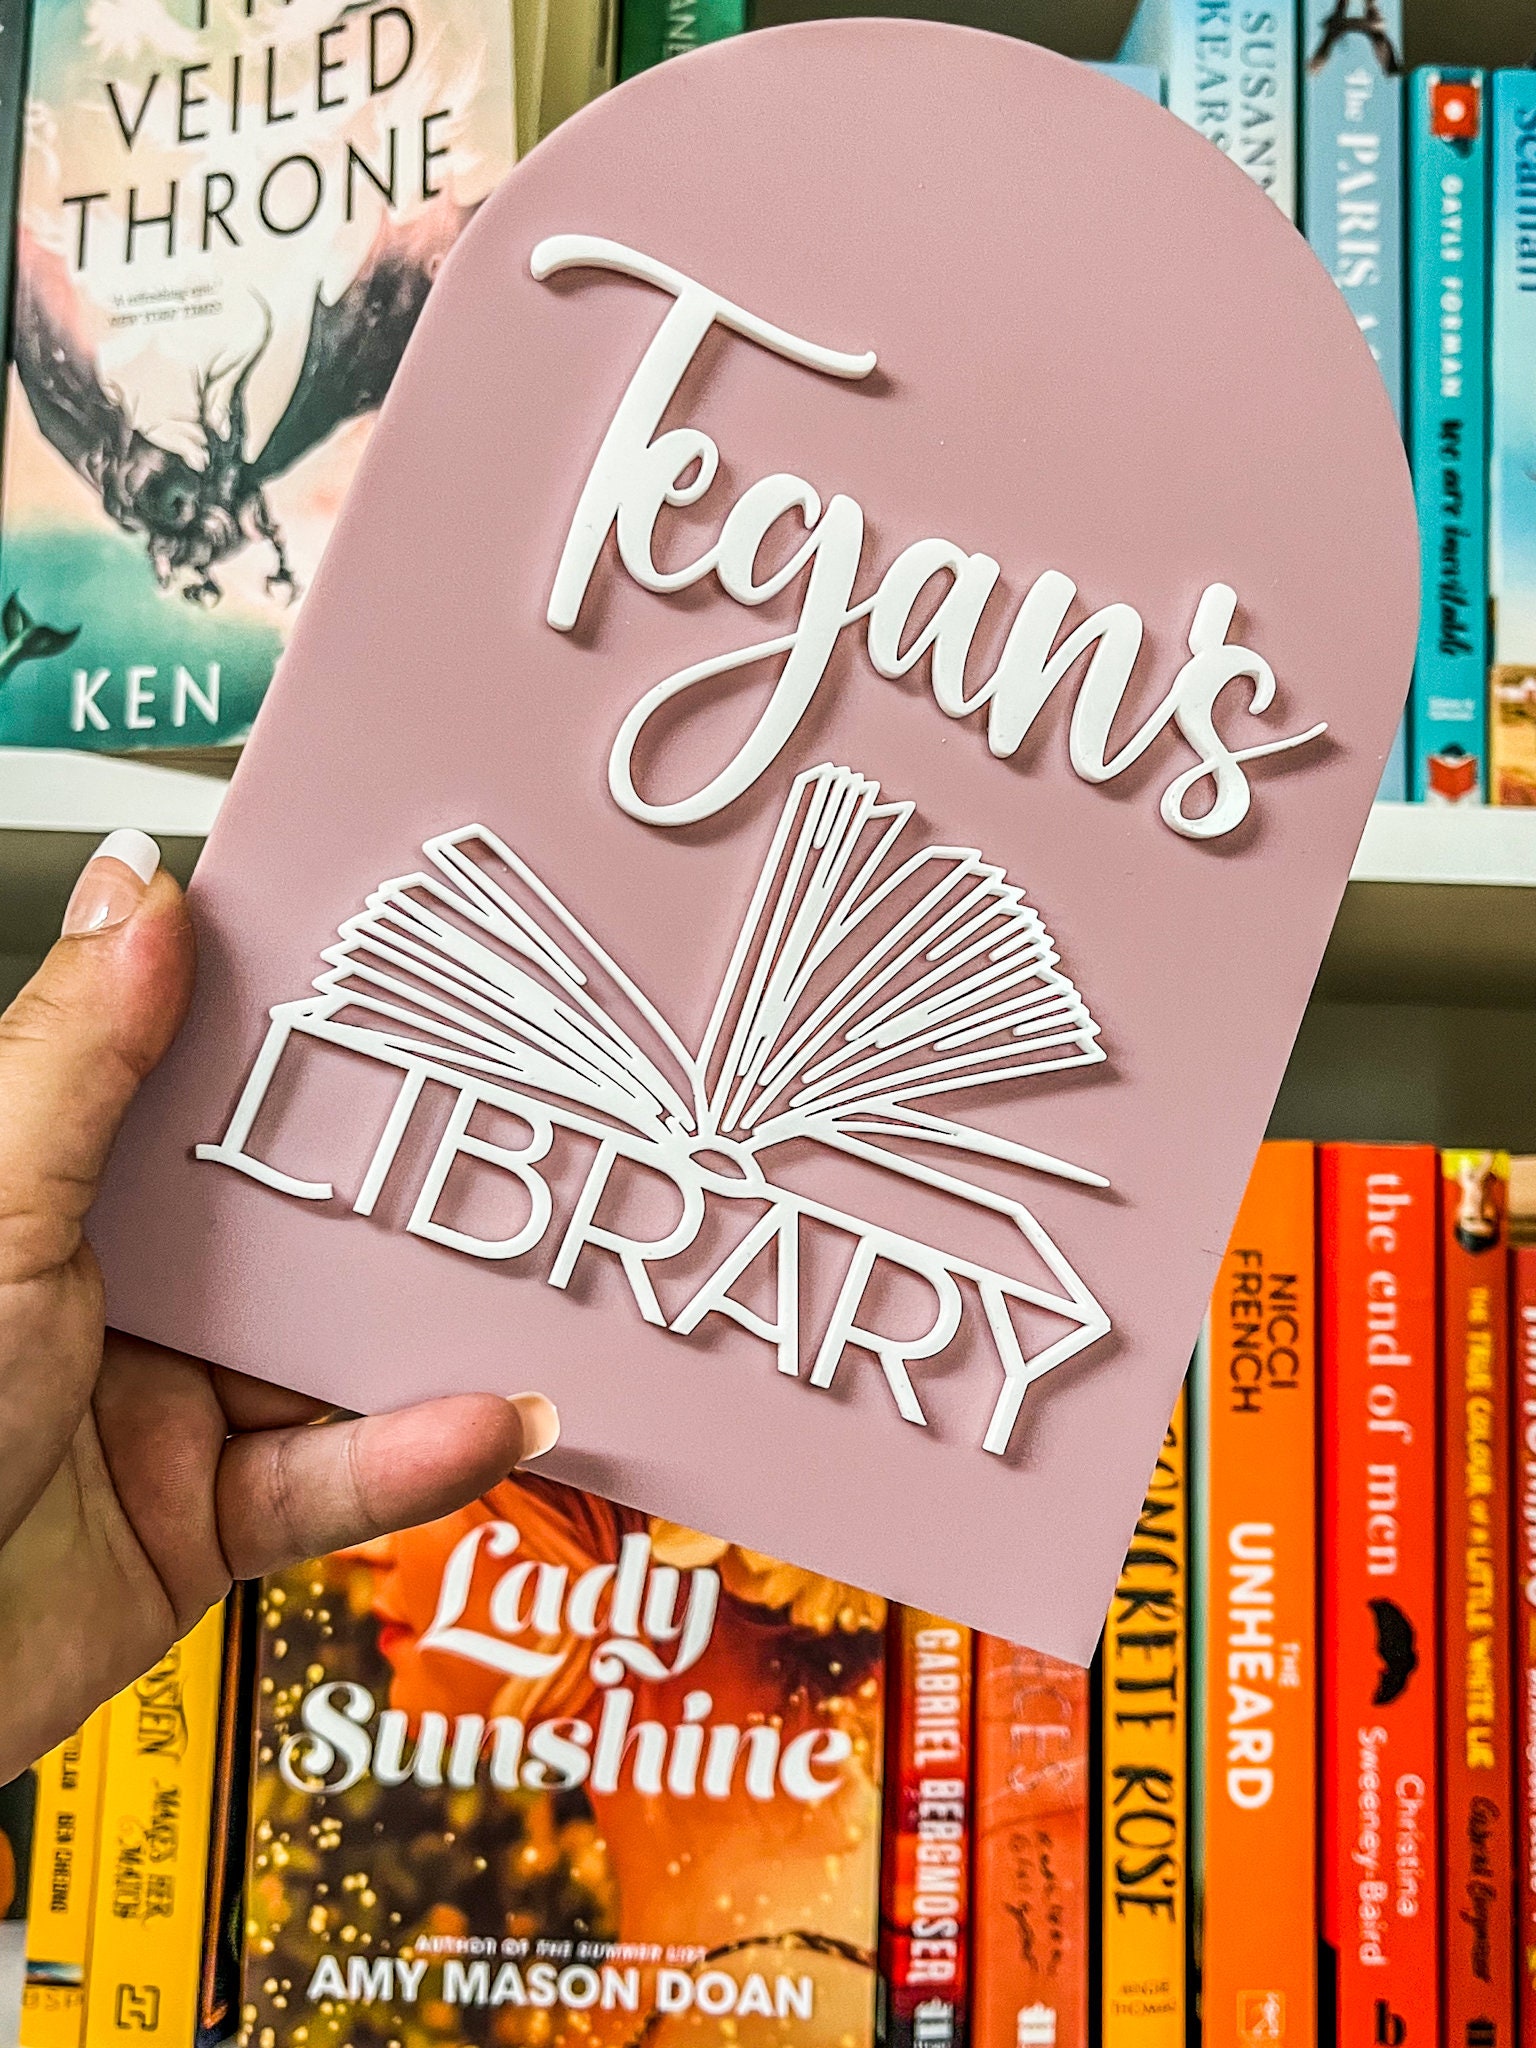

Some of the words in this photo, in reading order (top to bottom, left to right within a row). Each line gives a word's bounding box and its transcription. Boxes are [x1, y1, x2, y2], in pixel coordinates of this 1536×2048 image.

[106, 7, 416, 148] VEILED
[1241, 10, 1278, 190] SUSAN
[1344, 66, 1373, 122] The
[63, 110, 452, 271] THRONE
[1336, 133, 1380, 288] PARIS
[1440, 276, 1464, 398] FORMAN
[70, 662, 221, 732] KEN
[195, 1005, 1111, 1456] LIBRARY
[1366, 1173, 1413, 1253] the
[1229, 1248, 1264, 1414] FRENCH
[1266, 1273, 1300, 1390] NICCI
[1366, 1269, 1413, 1367] end
[1366, 1384, 1414, 1446] of
[1366, 1463, 1397, 1576] men
[418, 1520, 722, 1686] Lady
[1227, 1521, 1275, 1811] UNHEARD
[1278, 1641, 1301, 1689] THE
[279, 1681, 855, 1802] Sunshine
[914, 1628, 962, 1770] GABRIEL
[906, 1777, 965, 1985] BERGMOSER
[1112, 1764, 1177, 1925] ROSE
[1351, 1725, 1389, 1967] Sweeney-Baird
[1395, 1773, 1426, 1918] Christina
[307, 1954, 428, 2002] AMY
[441, 1959, 641, 2012] MASON
[656, 1969, 815, 2021] DOAN
